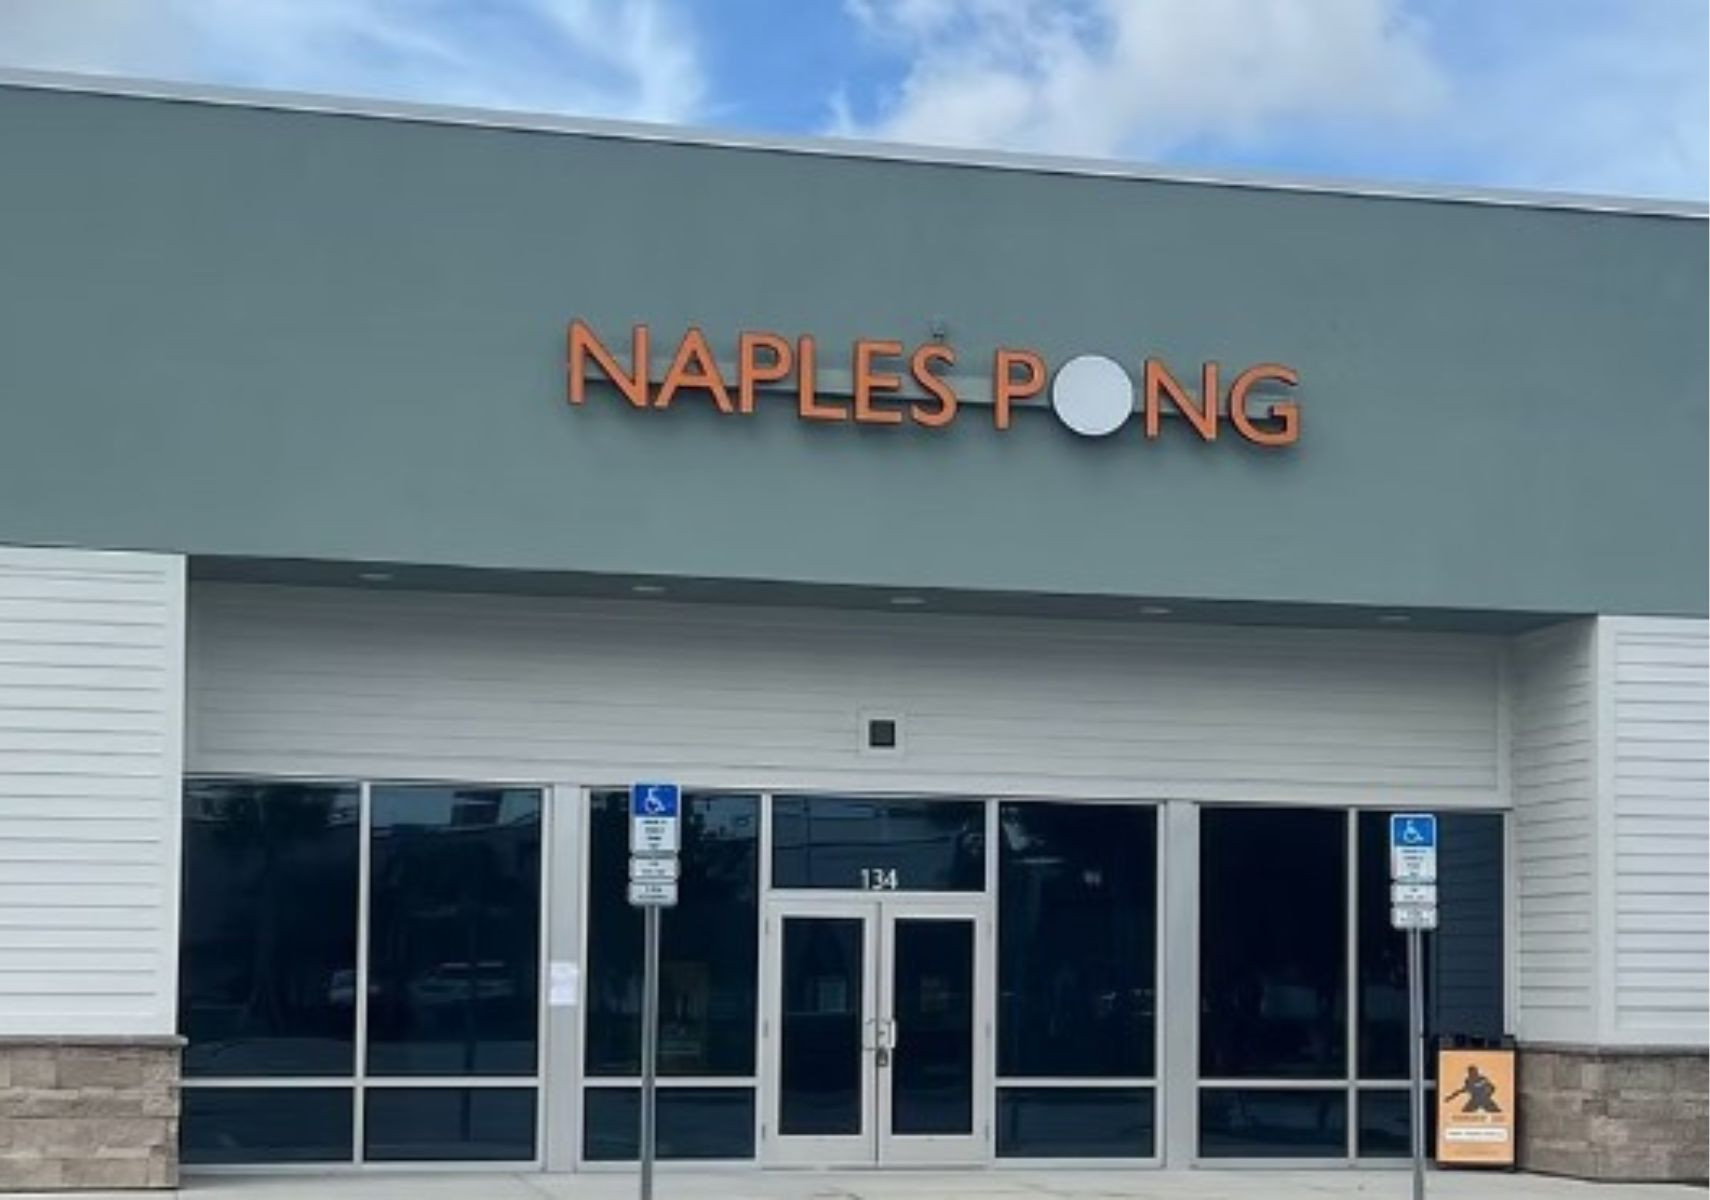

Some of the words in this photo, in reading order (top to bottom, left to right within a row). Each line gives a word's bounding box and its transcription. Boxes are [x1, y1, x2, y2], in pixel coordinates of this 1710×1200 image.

[567, 319, 959, 429] NAPLES
[995, 347, 1301, 447] PONG
[861, 868, 898, 891] 134
